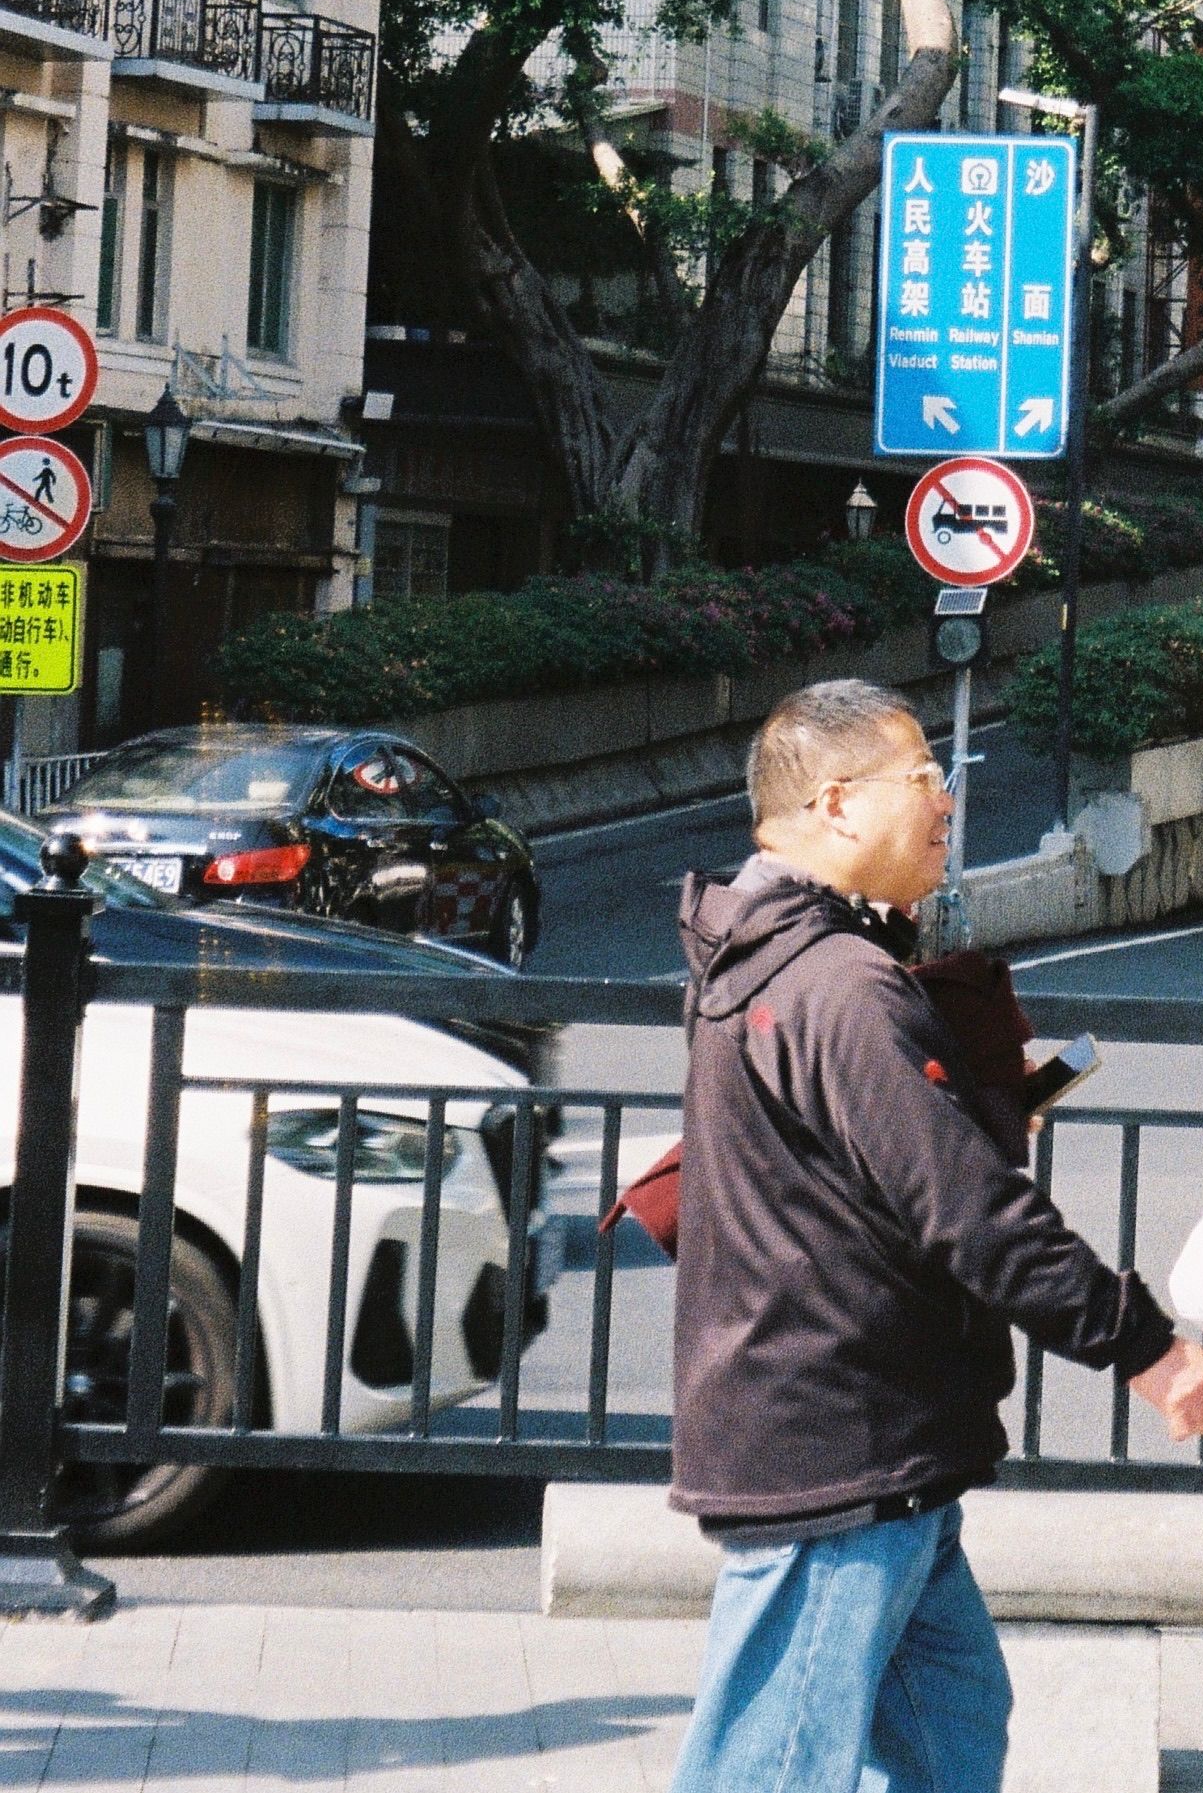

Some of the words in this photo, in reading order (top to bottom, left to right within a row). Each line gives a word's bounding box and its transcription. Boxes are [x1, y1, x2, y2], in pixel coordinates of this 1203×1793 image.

[900, 156, 933, 318] 人民高架
[1023, 159, 1055, 319] 沙面
[961, 201, 992, 319] 火车站
[889, 326, 938, 343] Renmin
[949, 327, 1000, 348] Railway
[1012, 330, 1059, 346] Shamian
[3, 341, 73, 399] 10t
[888, 353, 938, 369] Viaduct
[950, 354, 998, 371] Station
[1, 579, 71, 609] 非机动车
